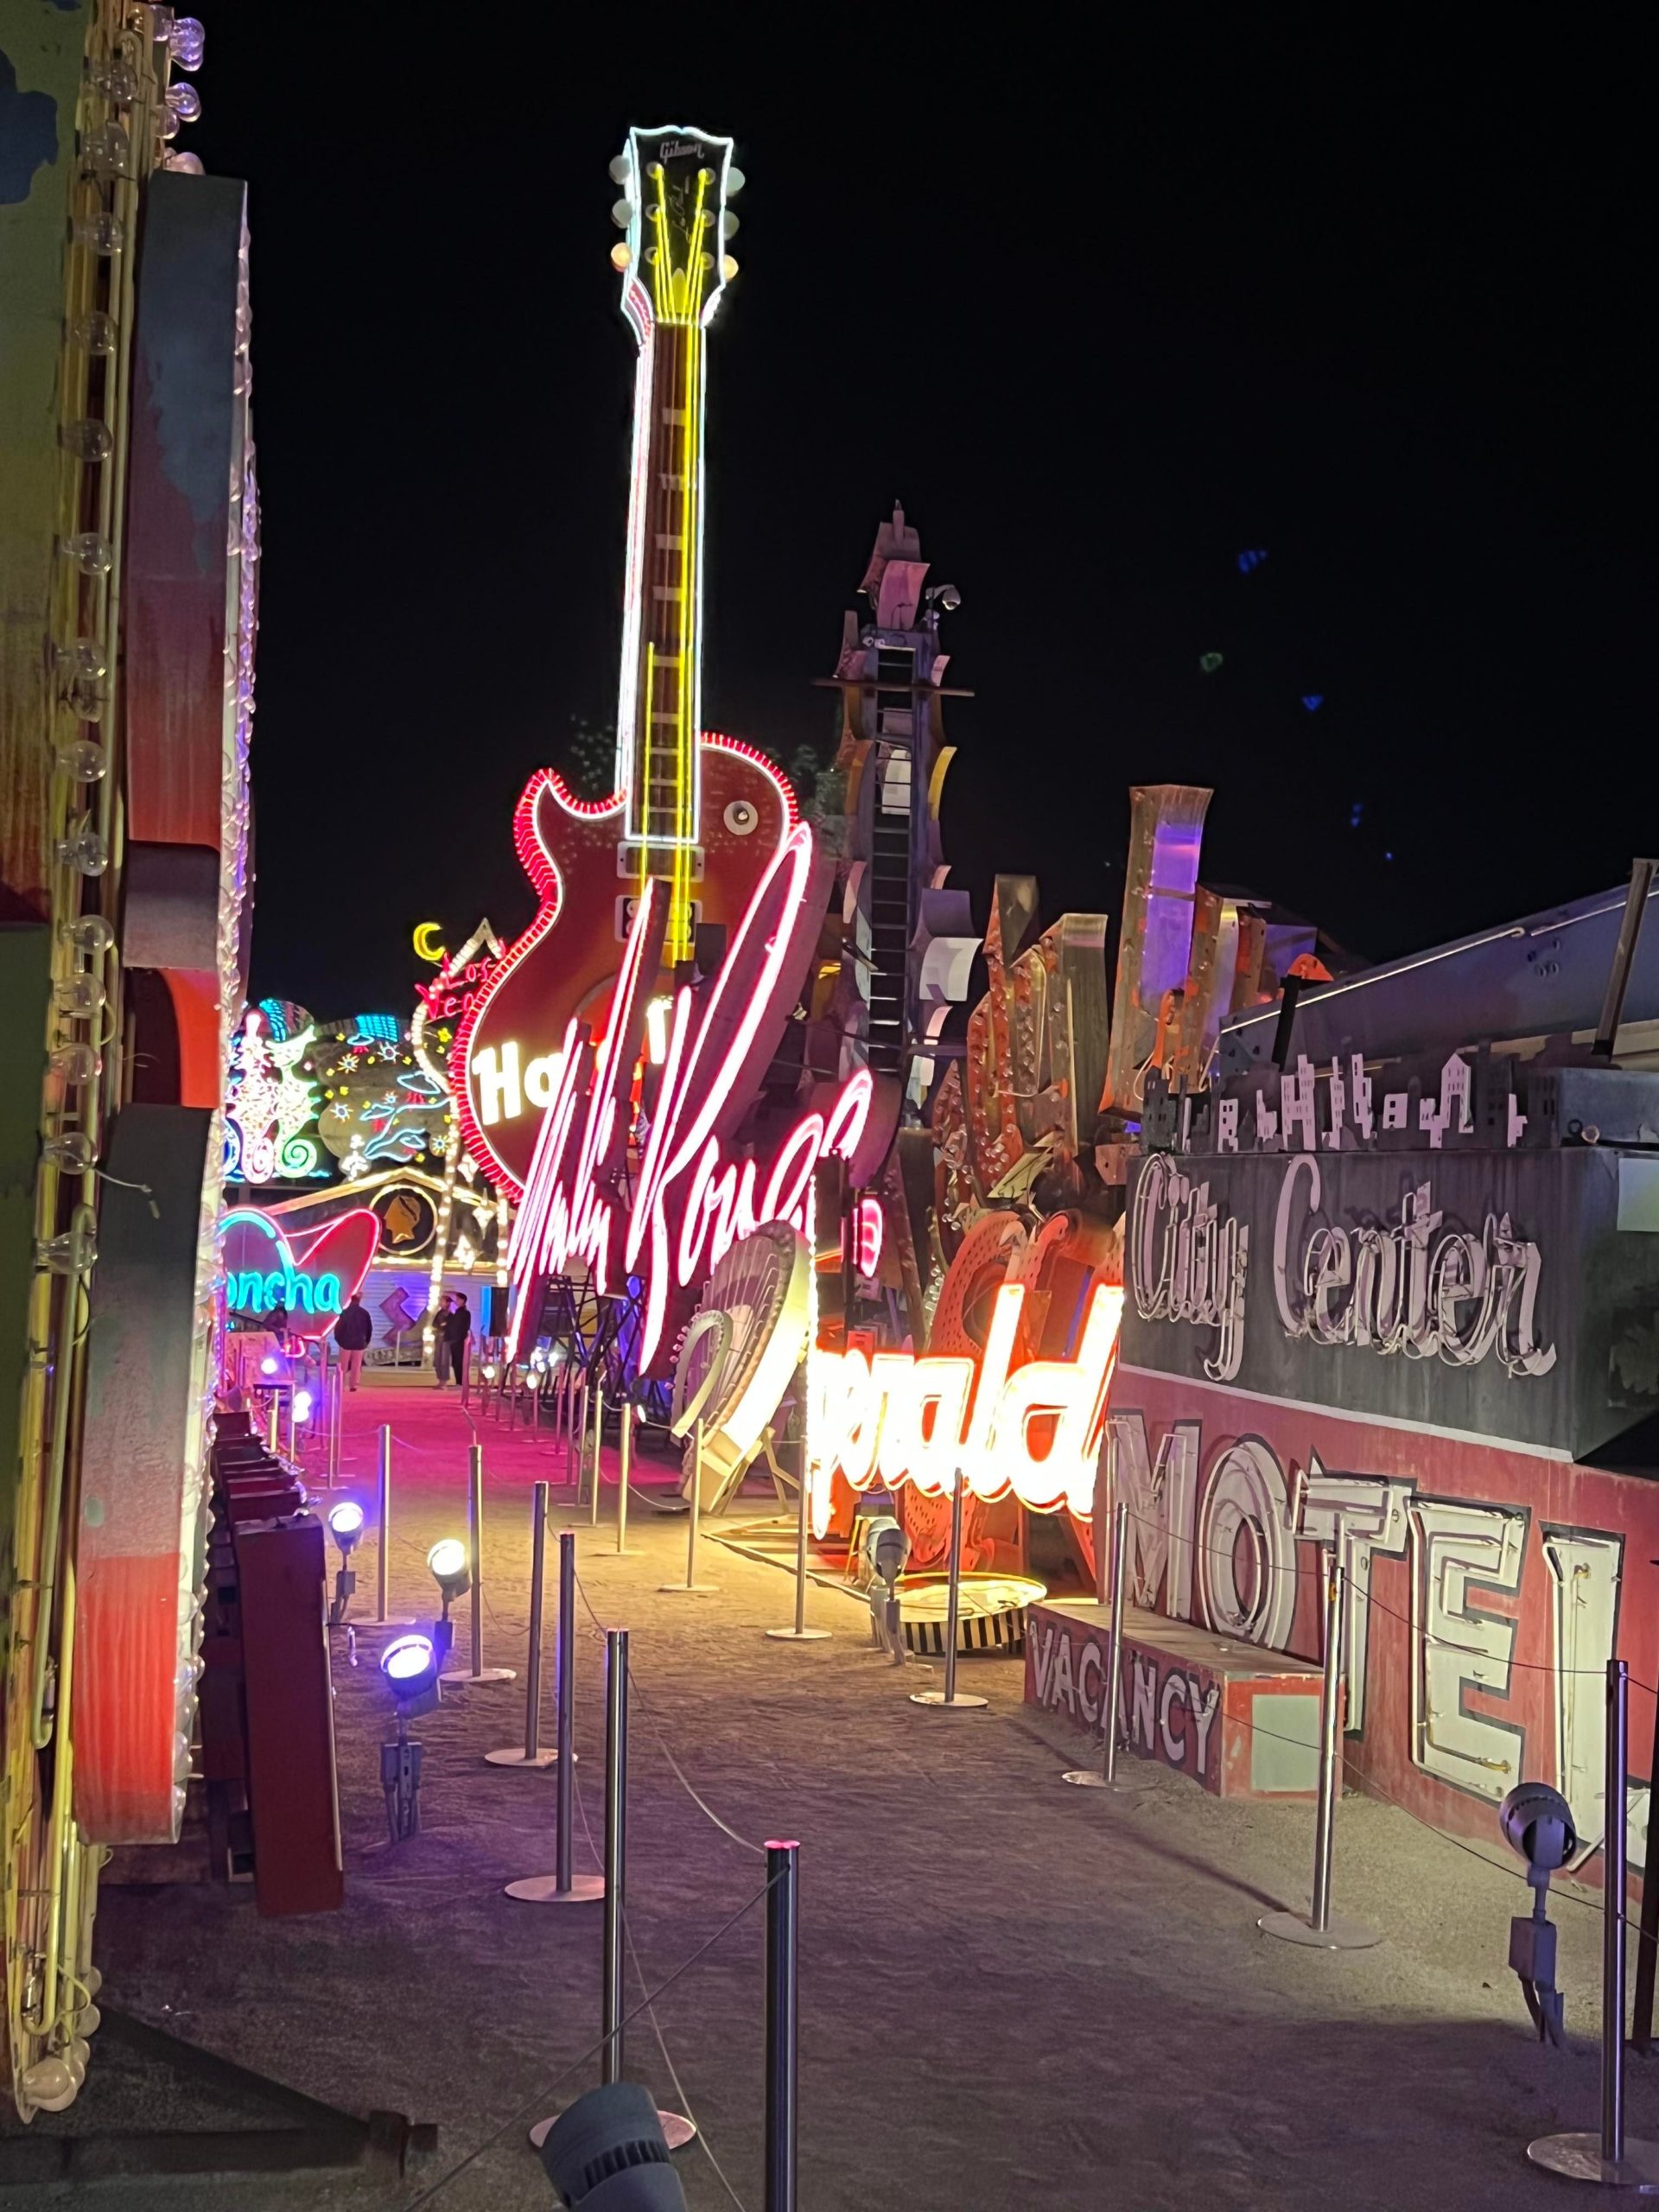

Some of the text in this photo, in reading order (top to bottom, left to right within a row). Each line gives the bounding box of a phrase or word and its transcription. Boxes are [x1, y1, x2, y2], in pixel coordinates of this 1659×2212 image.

[660, 141, 705, 163] Gibson
[471, 1039, 568, 1127] Ha
[1133, 1153, 1558, 1382] City Center
[1029, 1620, 1219, 1775] VACANCY
[1106, 1412, 1650, 1869] MOTEL
